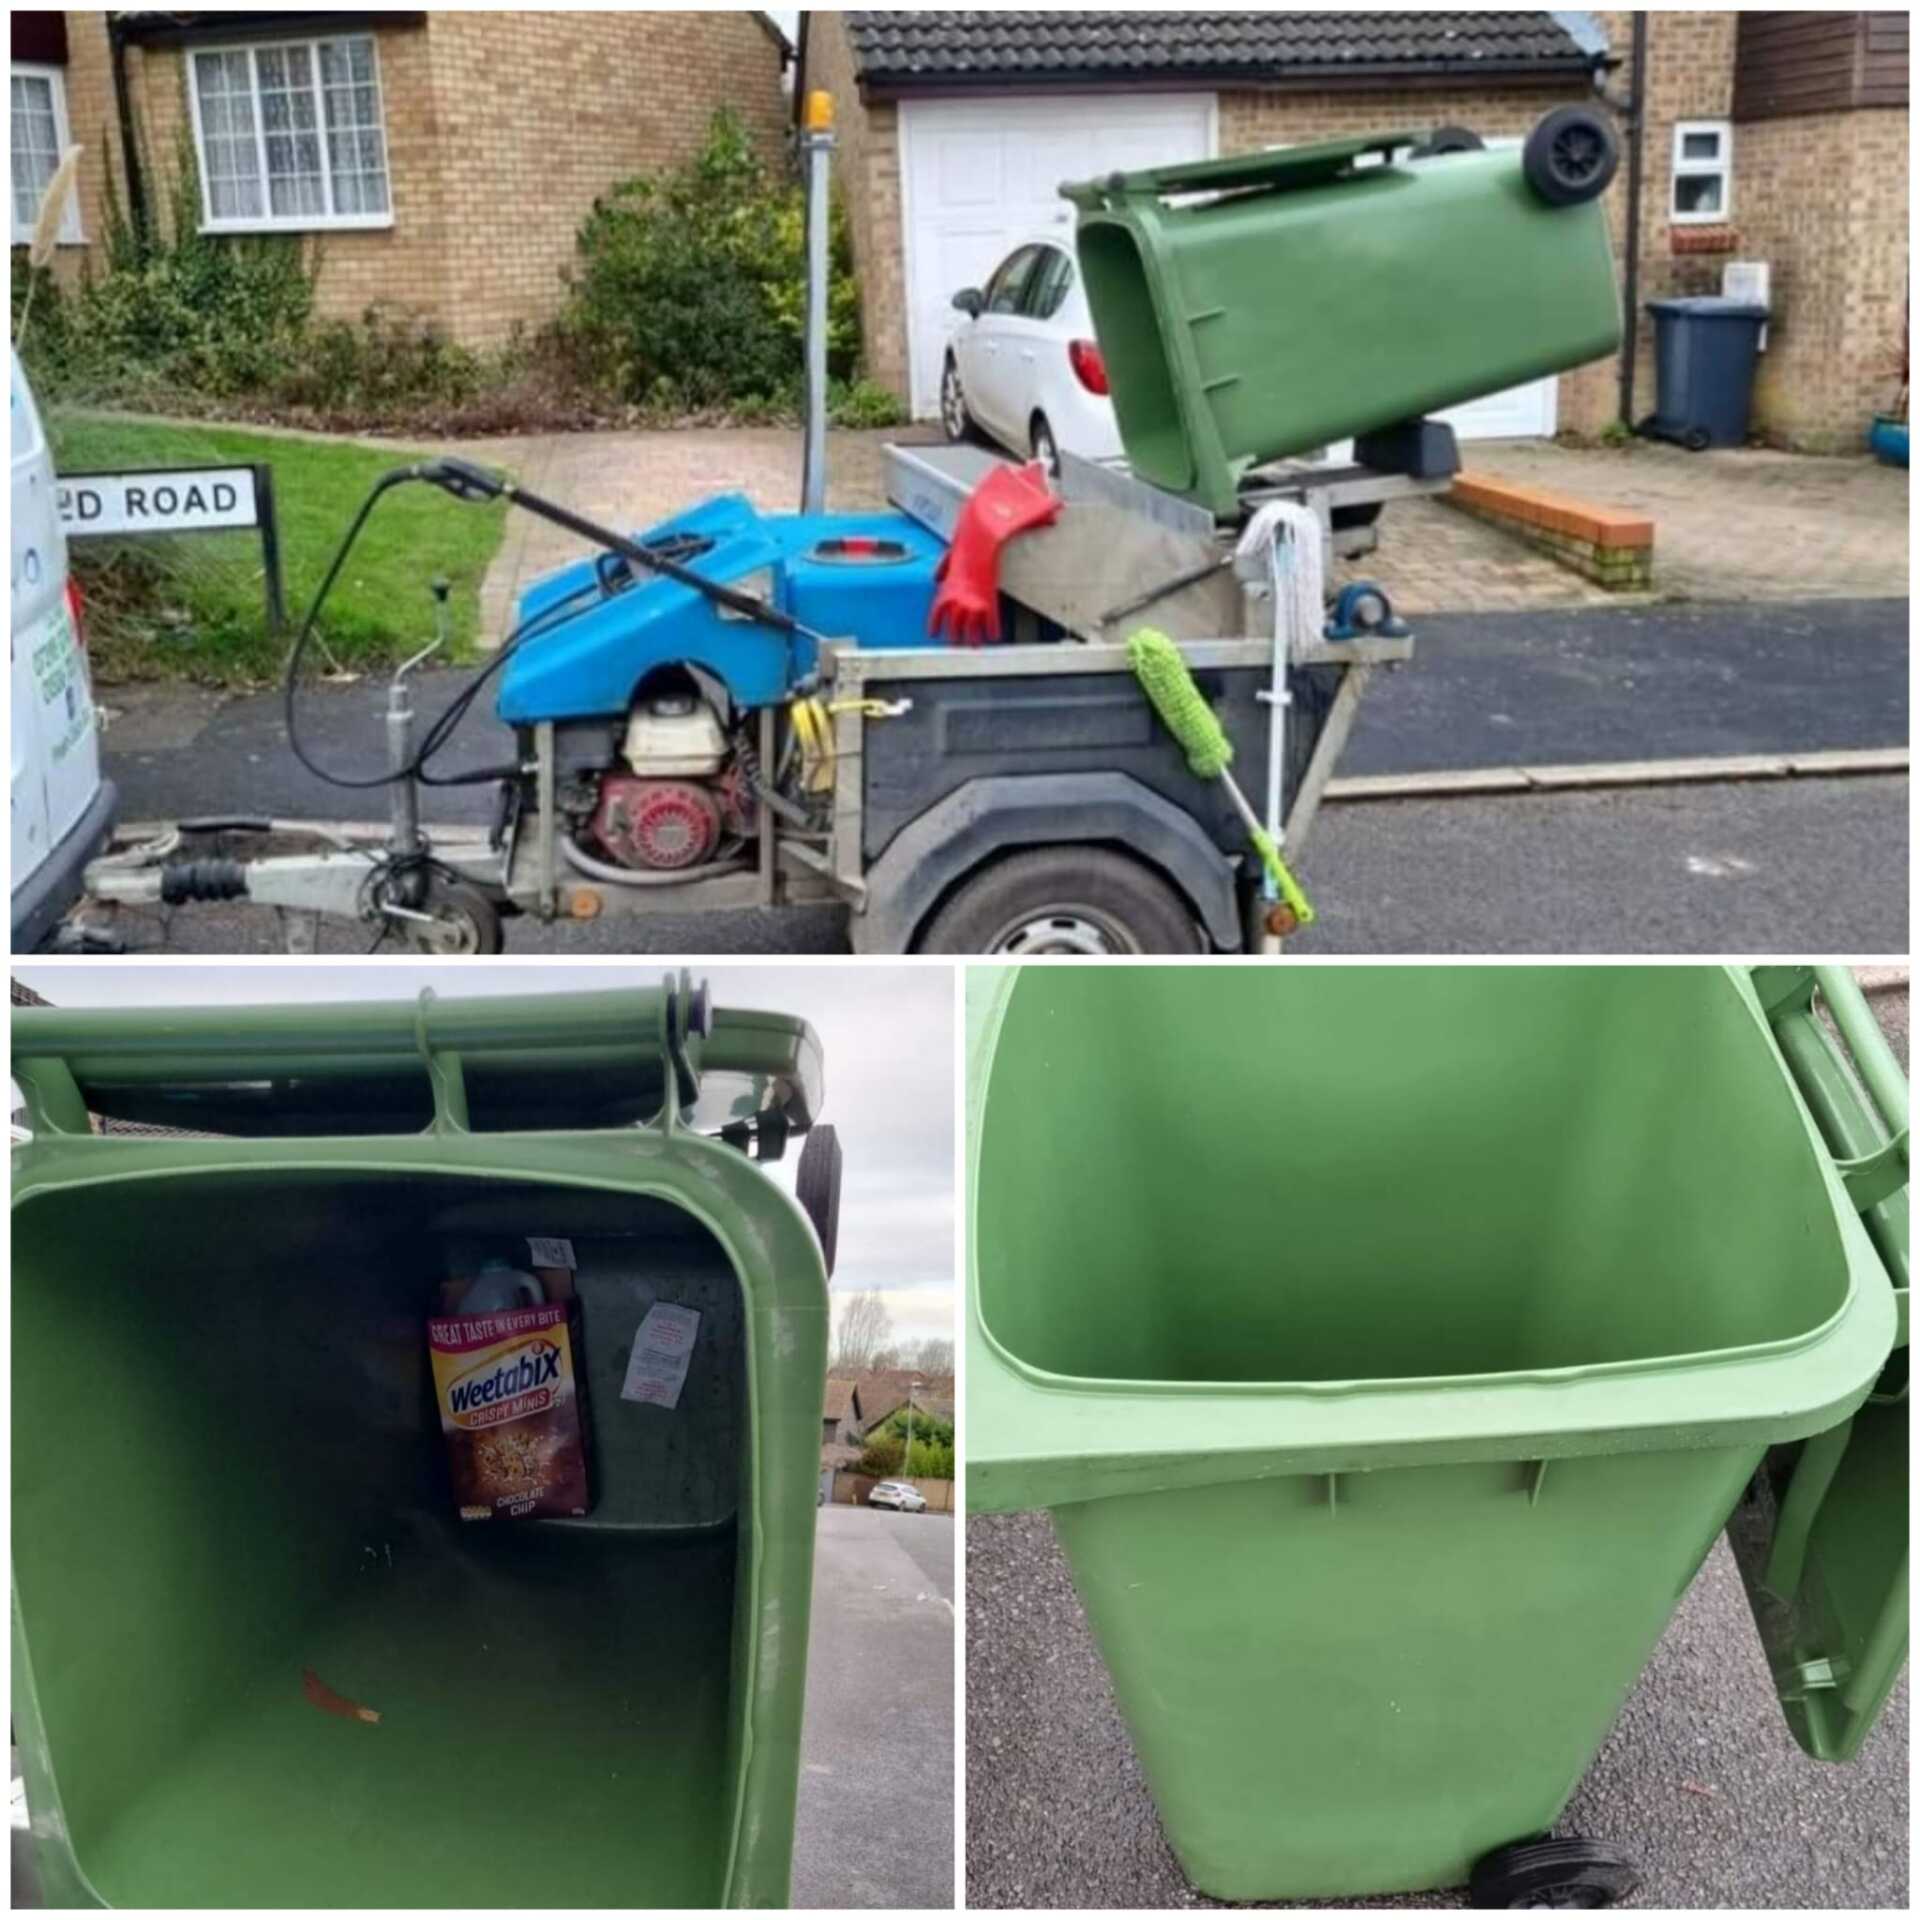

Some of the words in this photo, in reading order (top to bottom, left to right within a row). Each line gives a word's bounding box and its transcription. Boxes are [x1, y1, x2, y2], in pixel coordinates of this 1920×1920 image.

[125, 483, 237, 517] ROAD
[432, 1322, 463, 1345] GREAT
[462, 1319, 495, 1342] TASTE
[506, 1314, 538, 1331] EVERY
[538, 1309, 561, 1326] BITE
[496, 1487, 545, 1508] CHOCOLATE
[510, 1501, 536, 1516] CHIP
